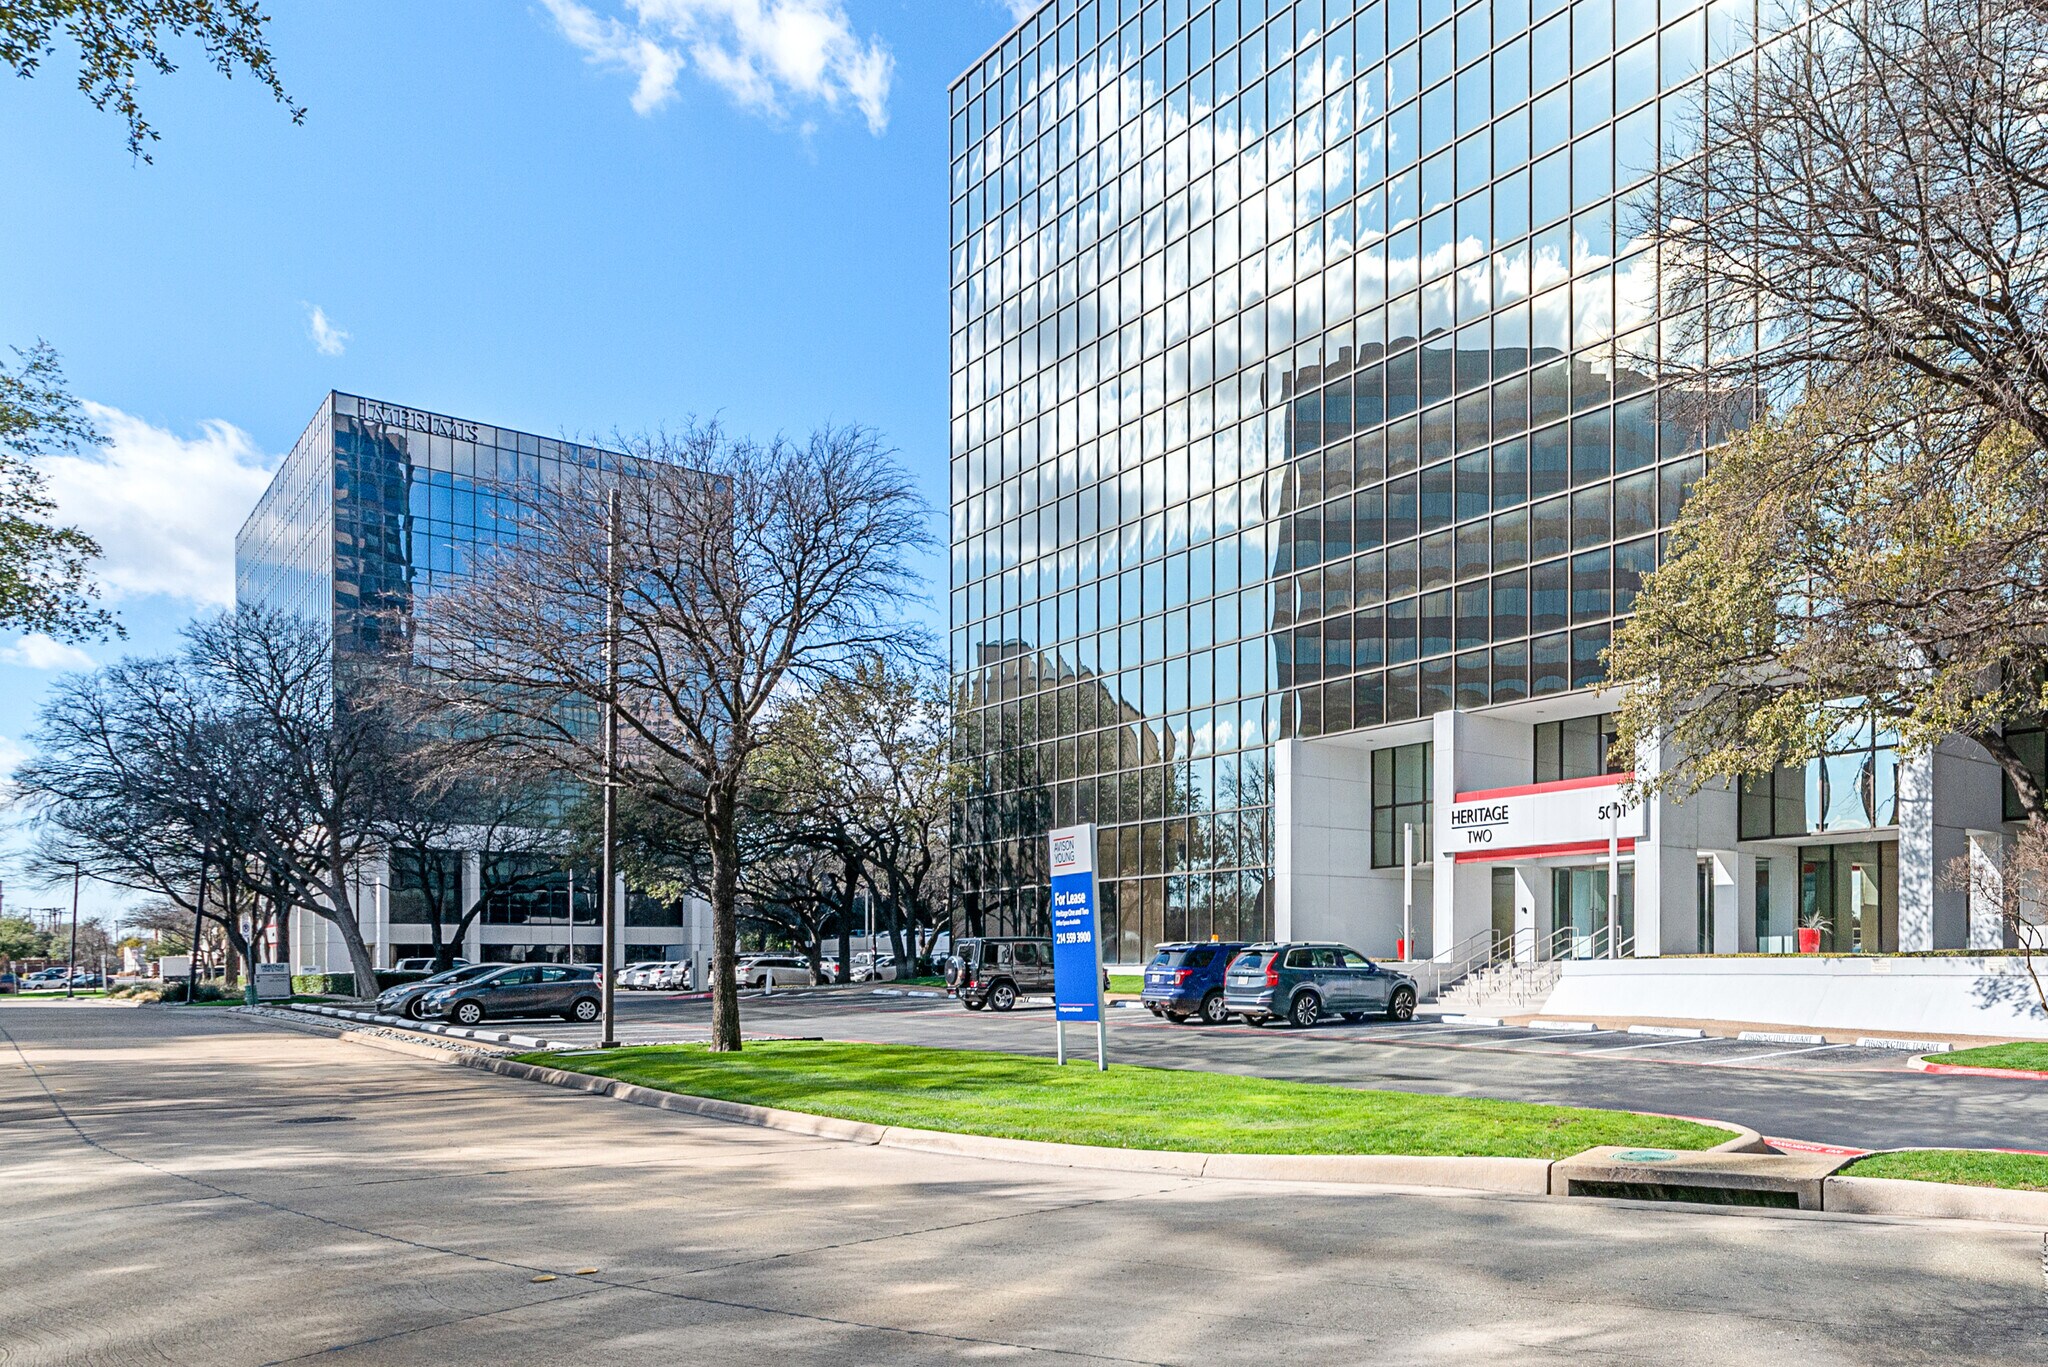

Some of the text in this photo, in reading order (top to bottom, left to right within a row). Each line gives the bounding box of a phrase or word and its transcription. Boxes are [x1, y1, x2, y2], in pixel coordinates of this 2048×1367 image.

[364, 398, 480, 443] IMPRIMIS
[1451, 805, 1509, 825] HERITAGE
[1467, 829, 1493, 844] TWO
[1053, 840, 1075, 852] AVISON
[1053, 851, 1075, 863] YOUNG
[1054, 891, 1086, 906] For Lease
[1056, 931, 1091, 944] 214 559 3900
[1788, 1035, 1813, 1043] TENANT
[1864, 1039, 1940, 1051] PROSPECTIVE TENANT
